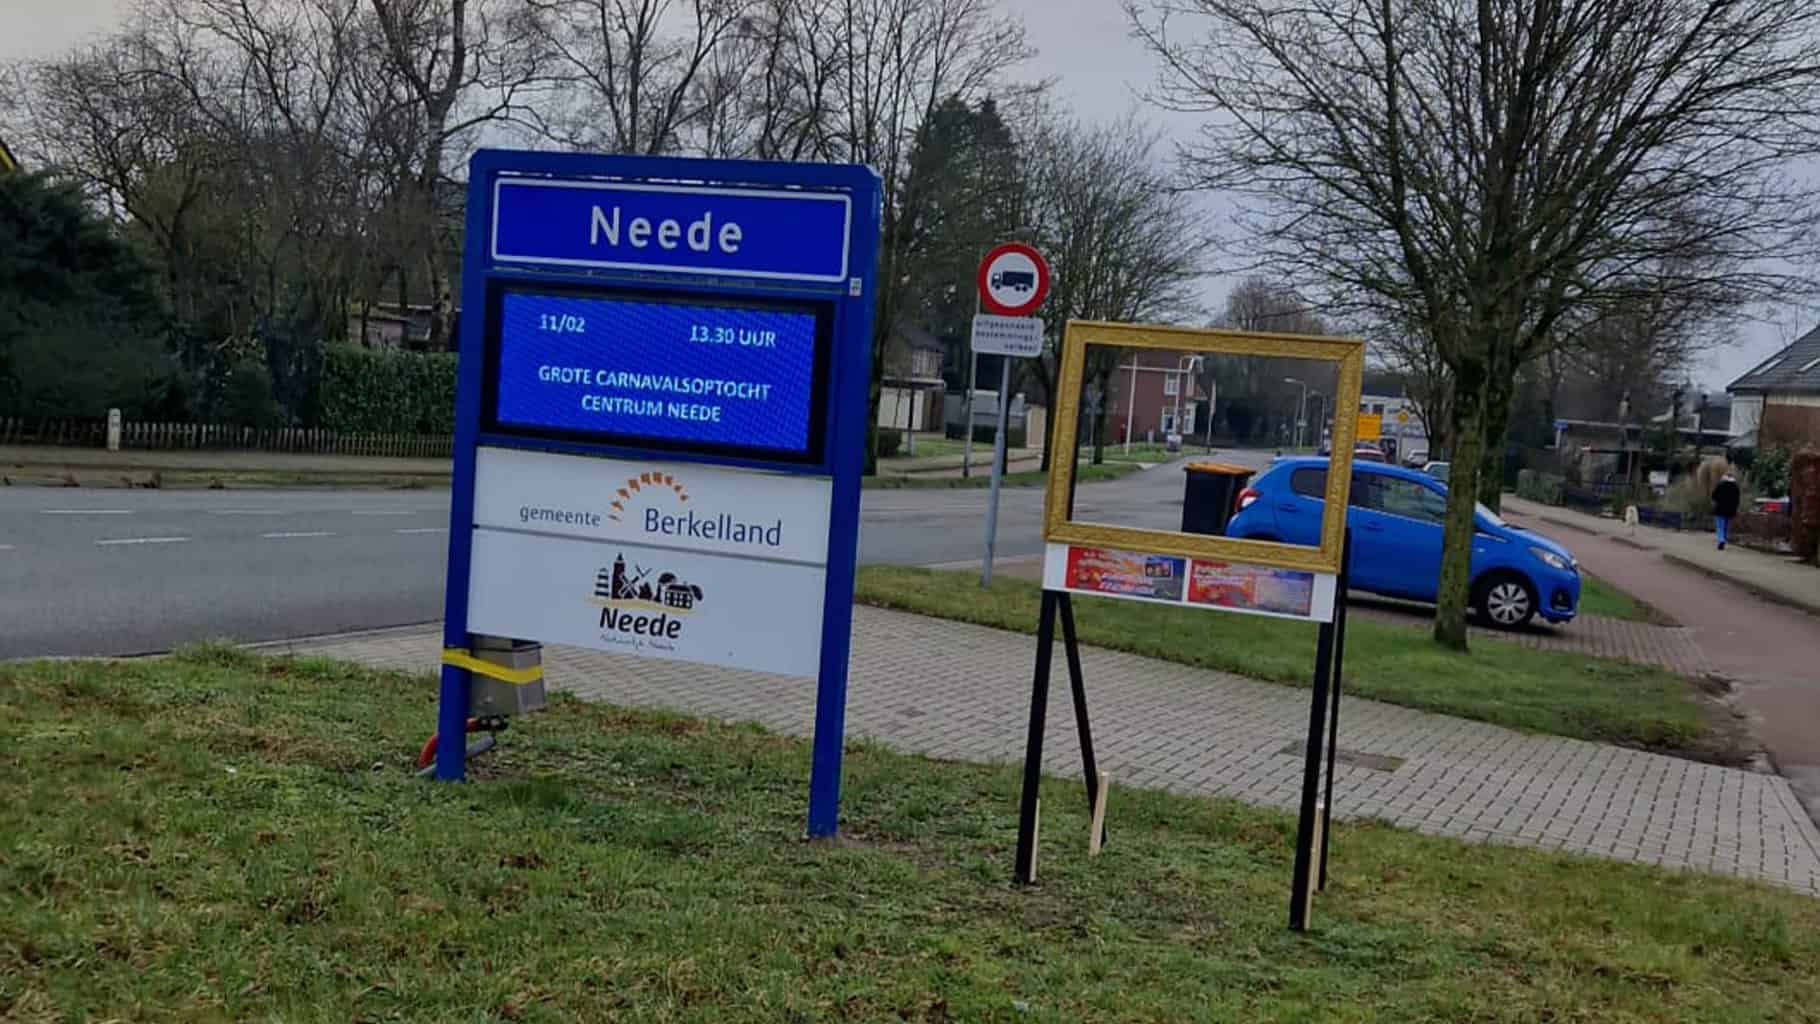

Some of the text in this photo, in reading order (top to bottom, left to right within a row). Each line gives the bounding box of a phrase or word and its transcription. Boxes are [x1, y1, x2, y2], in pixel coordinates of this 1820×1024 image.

[589, 205, 743, 253] Neede
[539, 313, 586, 333] 11/02
[689, 325, 776, 347] 13.30 UUR
[538, 365, 771, 400] GROTE CARNAVALSOPTOCHT
[581, 395, 721, 422] CENTRUM NEEDE
[519, 504, 600, 528] gemeente
[644, 508, 782, 546] Berkelland
[599, 607, 682, 639] Neede
